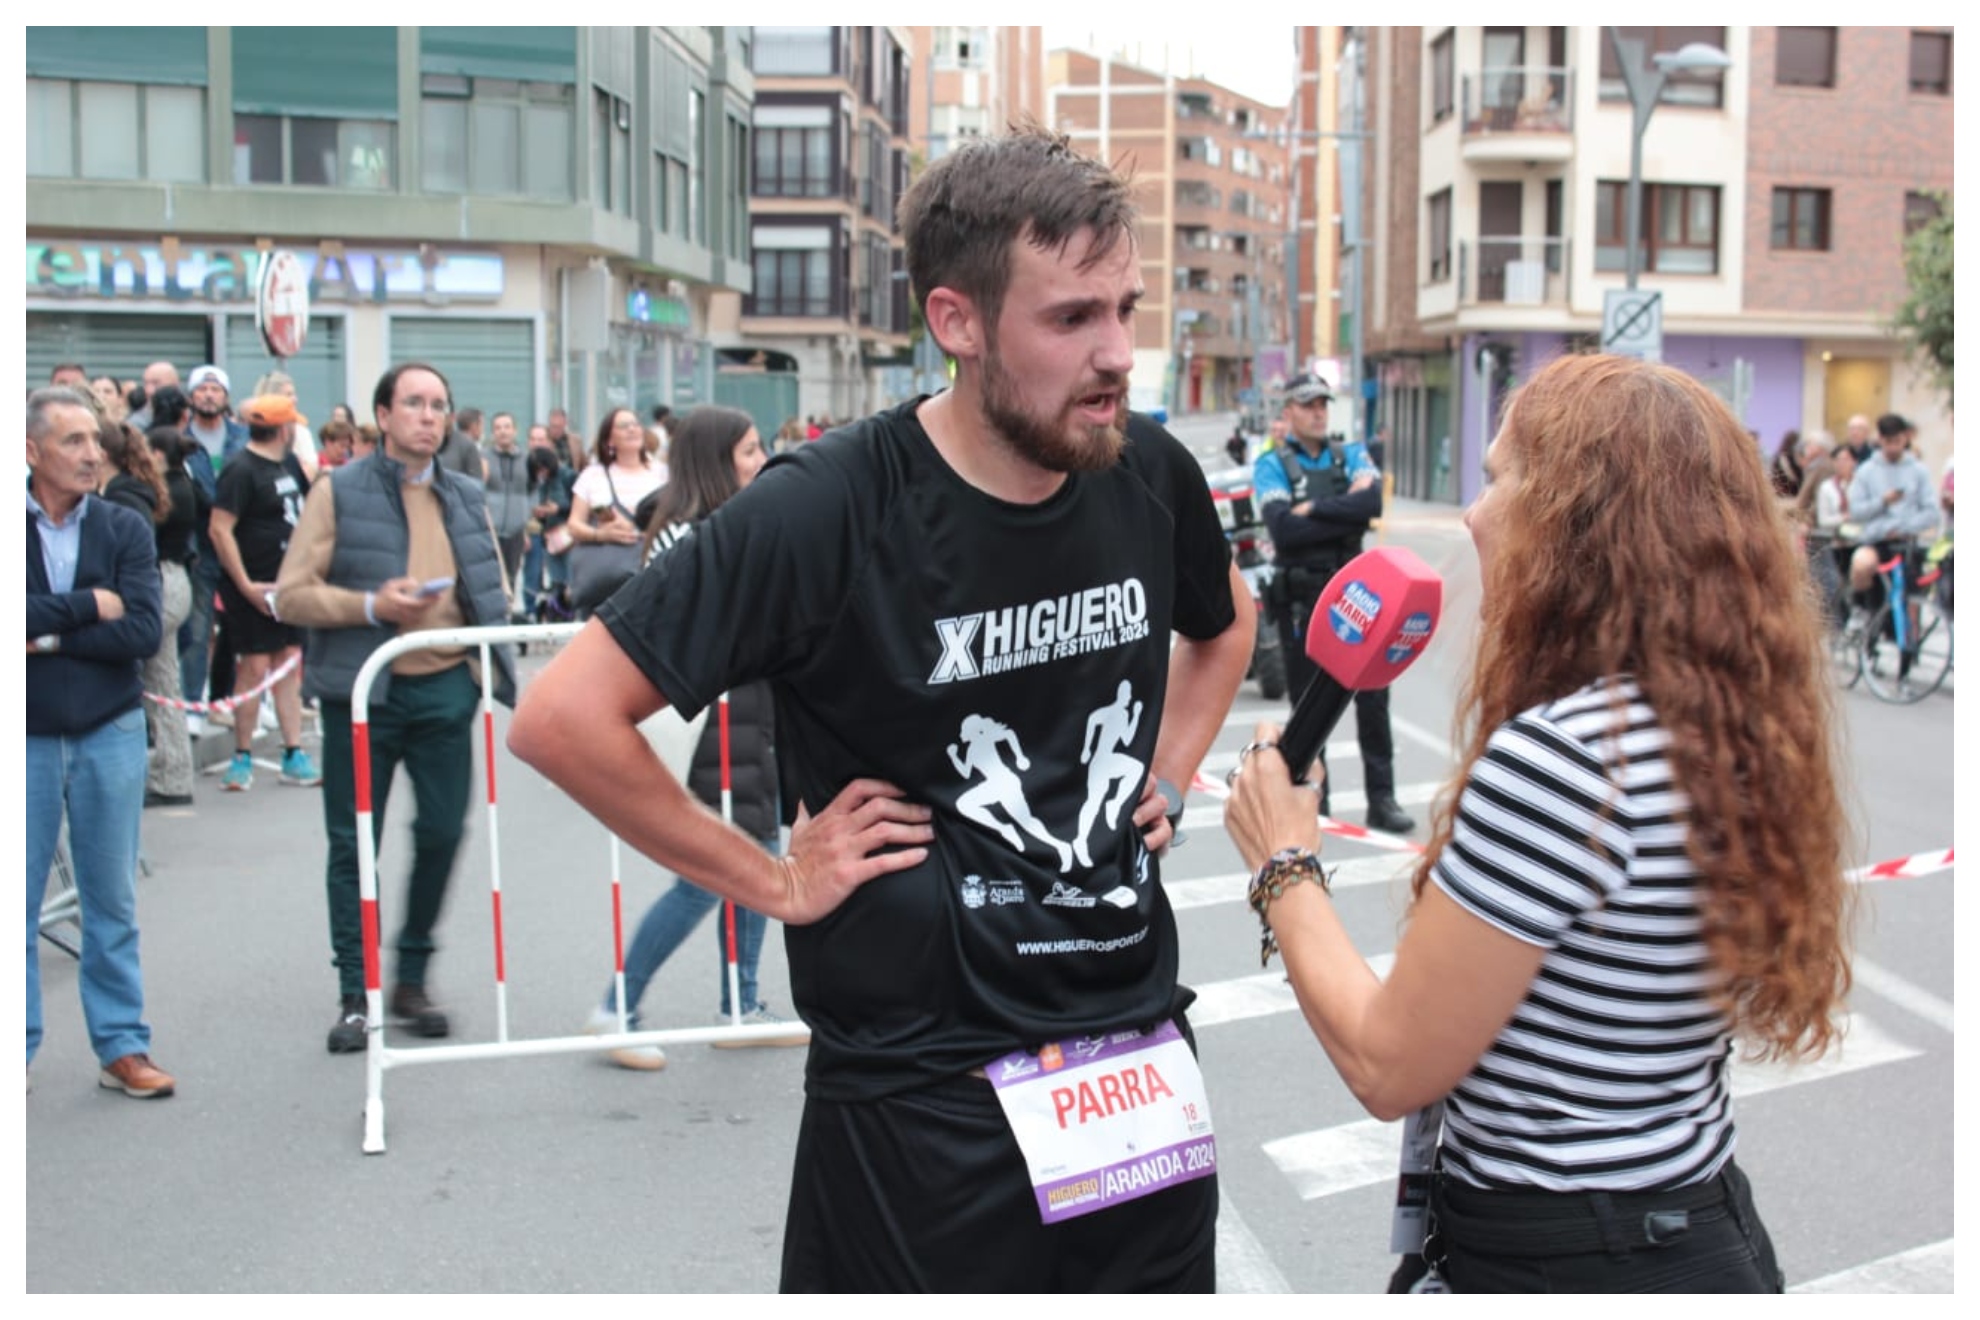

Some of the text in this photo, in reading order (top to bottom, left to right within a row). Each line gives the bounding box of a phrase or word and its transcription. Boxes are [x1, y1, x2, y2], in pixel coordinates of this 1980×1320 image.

[1344, 581, 1380, 618] RADIO
[927, 577, 1147, 684] X HIGUERO
[982, 619, 1149, 676] RUNNING FESTIVAL 2024
[1051, 1063, 1174, 1130] PARRA
[1182, 1102, 1197, 1122] 18
[1048, 1178, 1099, 1205] HIGUERO
[1105, 1151, 1184, 1198] ARANDA
[1184, 1141, 1215, 1172] 2024
